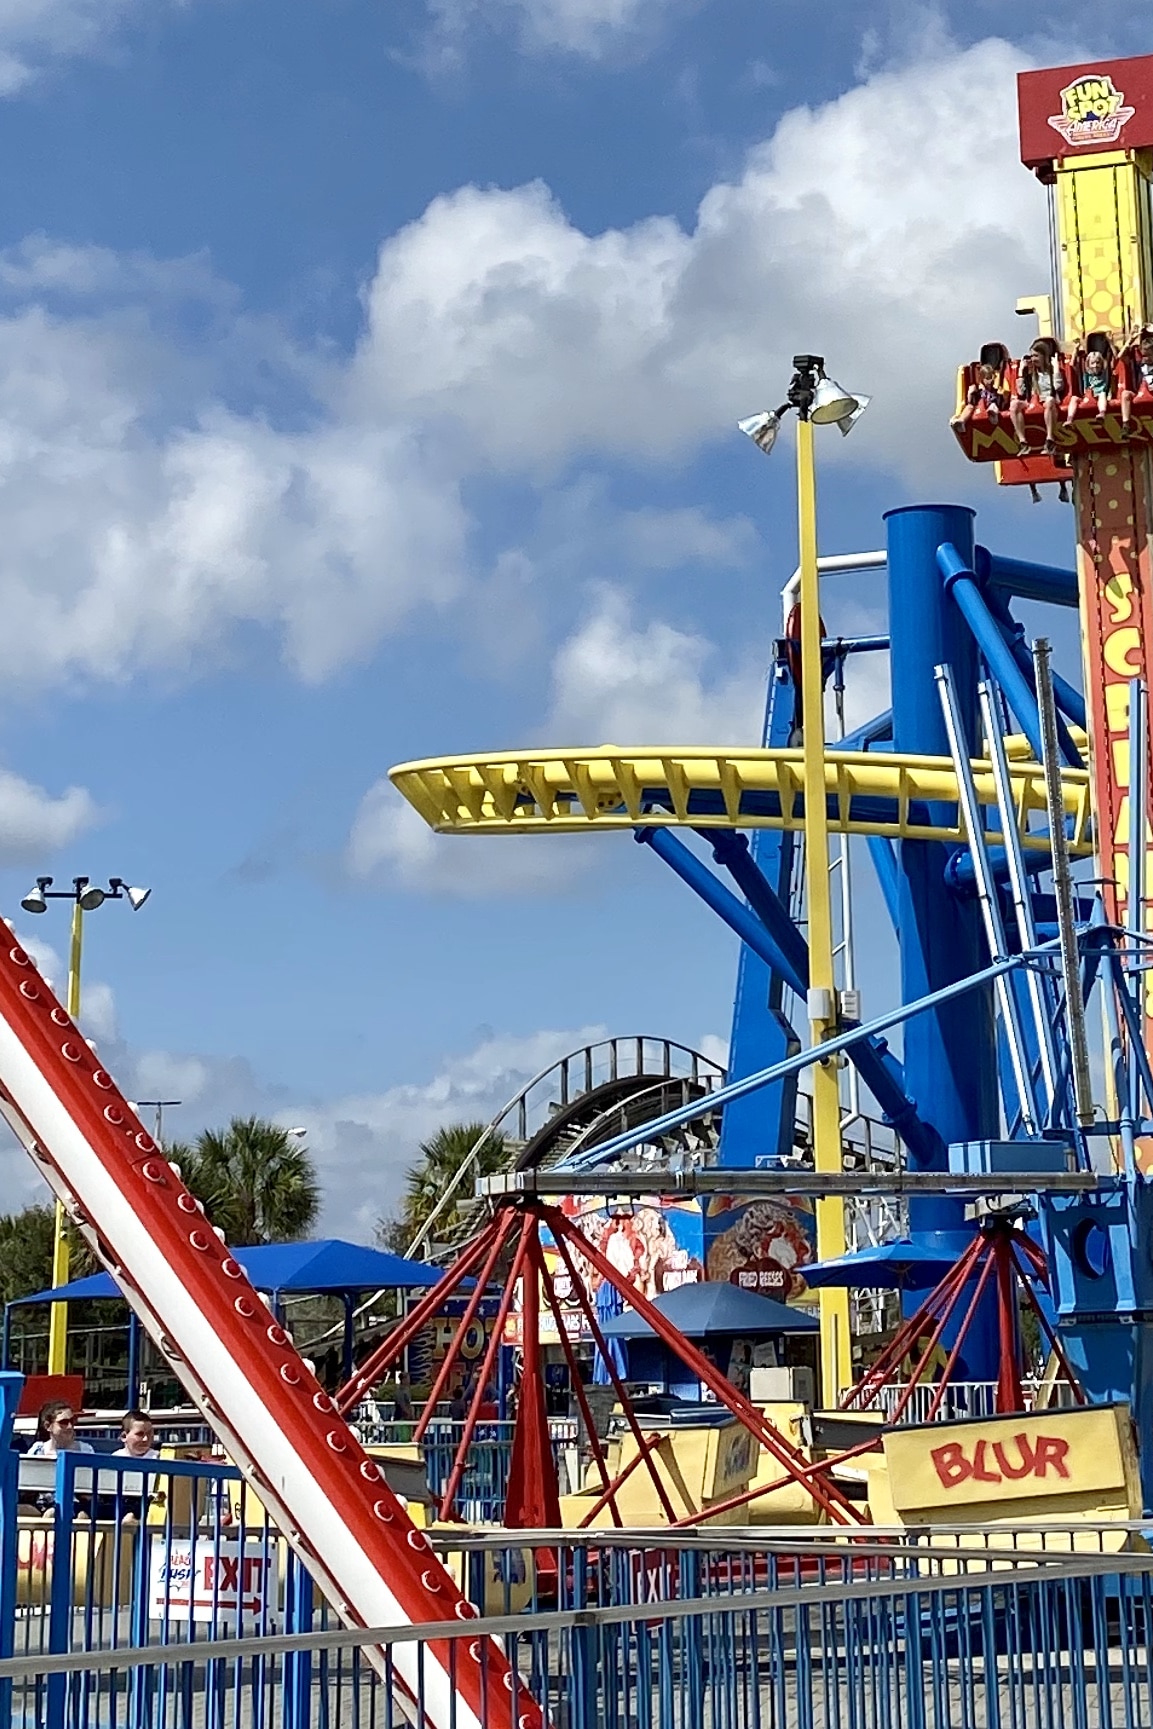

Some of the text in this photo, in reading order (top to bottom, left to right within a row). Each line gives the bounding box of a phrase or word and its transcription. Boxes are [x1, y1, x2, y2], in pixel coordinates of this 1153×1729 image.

[1066, 81, 1109, 107] FUN
[1067, 95, 1120, 120] SPOT
[1066, 118, 1118, 132] AMERICA
[432, 1316, 497, 1360] HO
[930, 1433, 1070, 1488] BLUR
[204, 1556, 272, 1593] EXIT
[636, 1564, 681, 1605] XI
